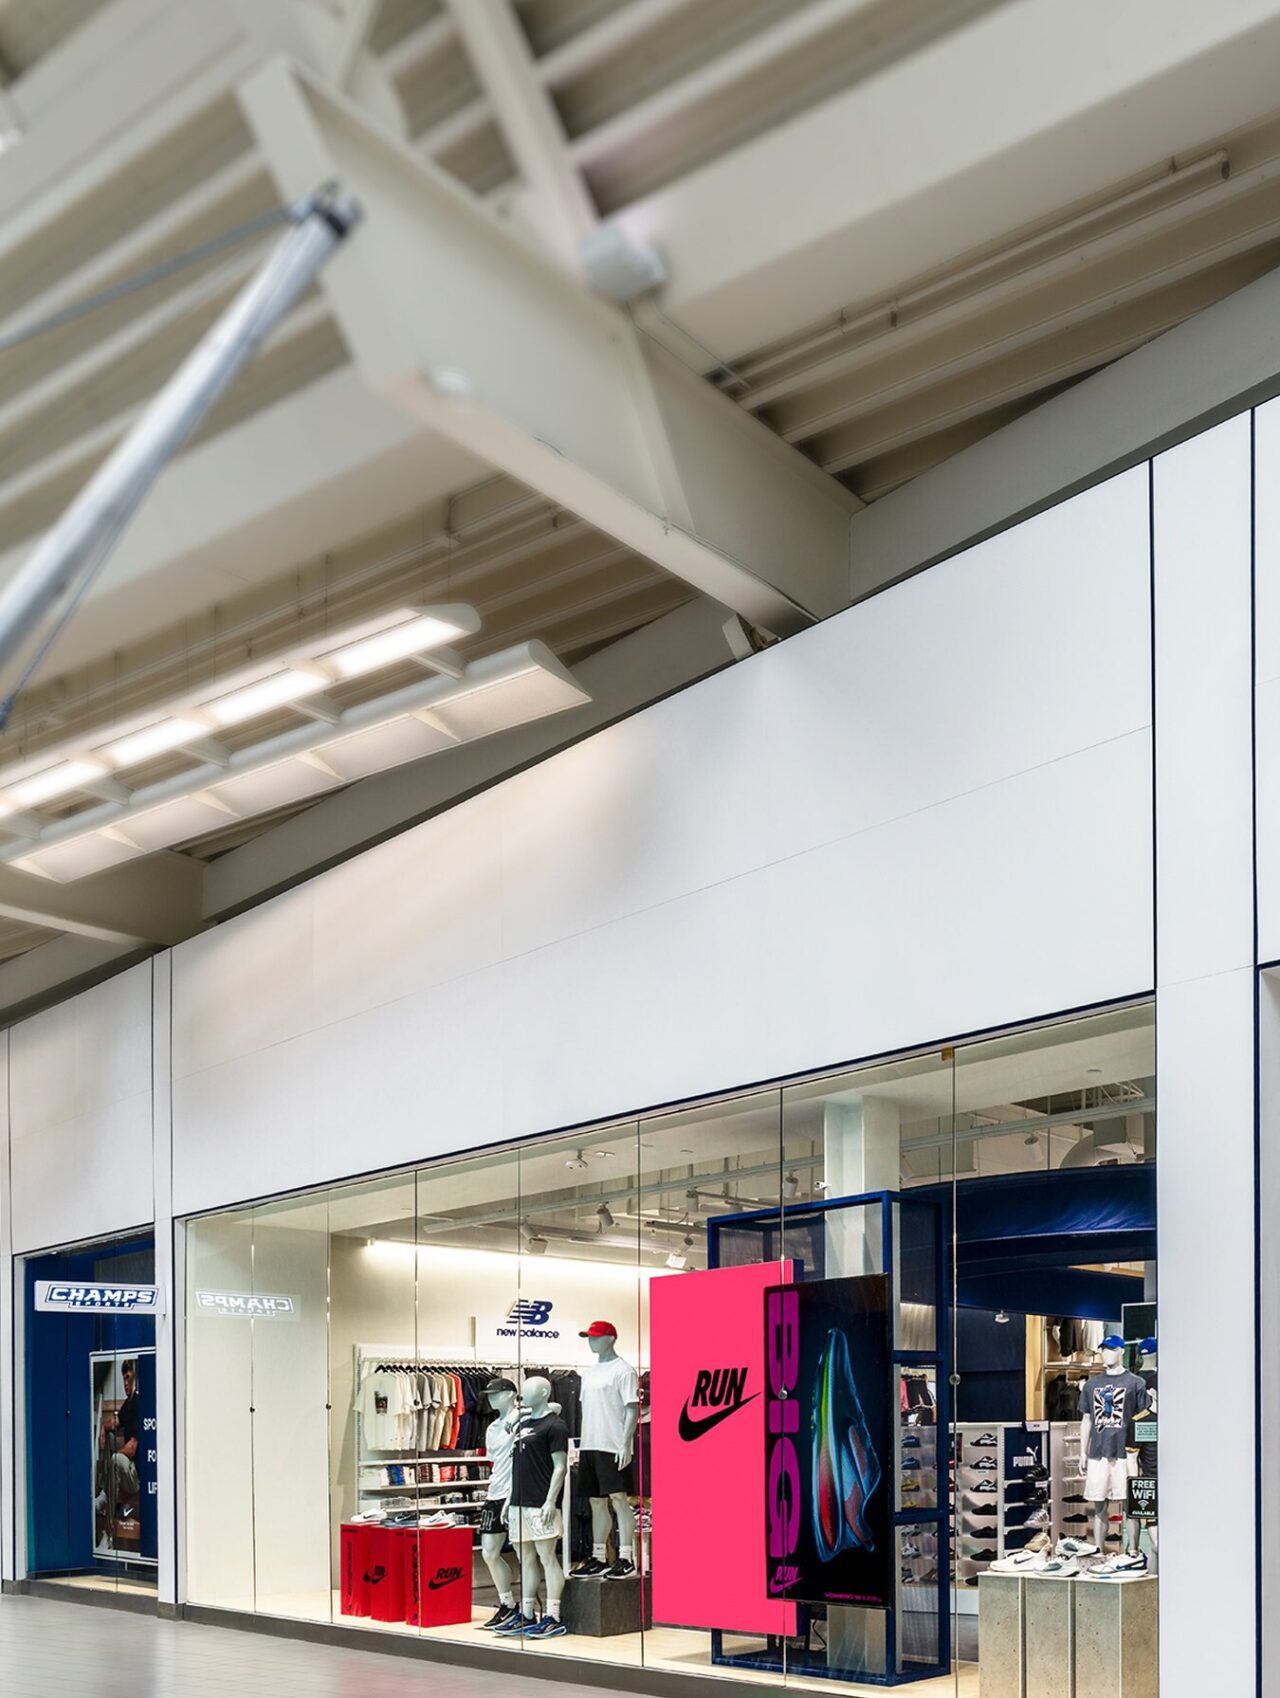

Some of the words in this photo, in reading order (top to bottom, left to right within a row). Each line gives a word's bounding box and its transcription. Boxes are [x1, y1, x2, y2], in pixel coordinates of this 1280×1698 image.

[51, 1287, 153, 1303] CHAMPS
[496, 1328, 517, 1337] new
[519, 1328, 560, 1339] balance
[691, 1367, 748, 1408] RUN
[143, 1418, 157, 1431] SPO
[768, 1291, 799, 1558] BIG
[147, 1450, 157, 1463] FO
[147, 1481, 158, 1494] LIF
[1131, 1480, 1156, 1489] FREE
[1131, 1489, 1156, 1500] WiFi
[435, 1567, 462, 1579] RUN
